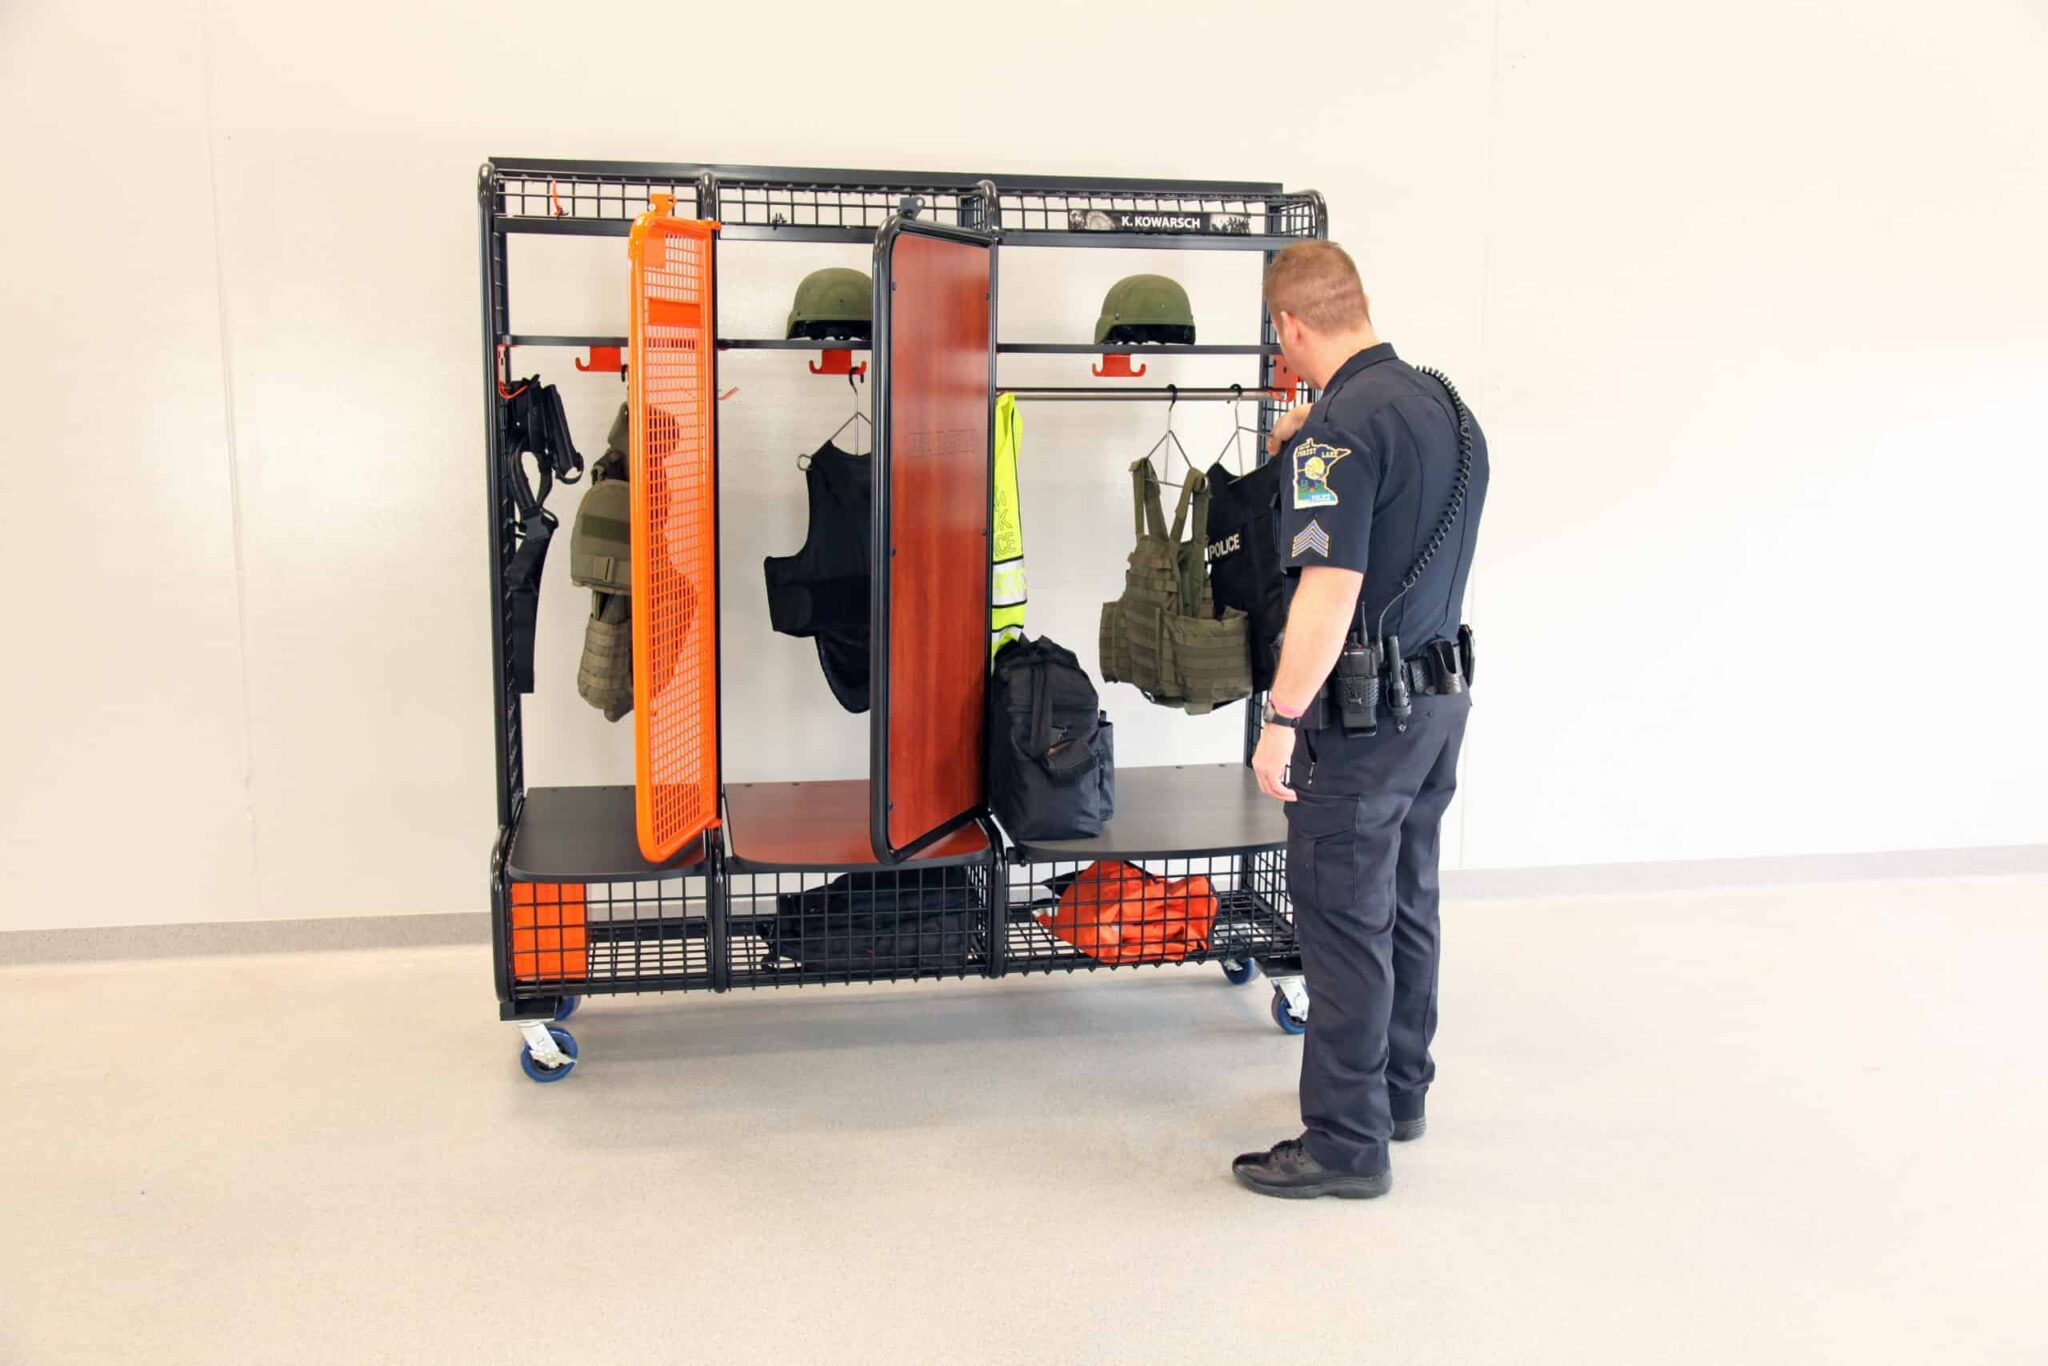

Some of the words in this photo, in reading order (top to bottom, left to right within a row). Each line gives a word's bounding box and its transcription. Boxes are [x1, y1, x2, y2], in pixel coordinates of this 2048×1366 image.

[1121, 216, 1133, 227] K.
[1135, 216, 1200, 229] KOWARSCH
[1209, 533, 1240, 560] POLICE
